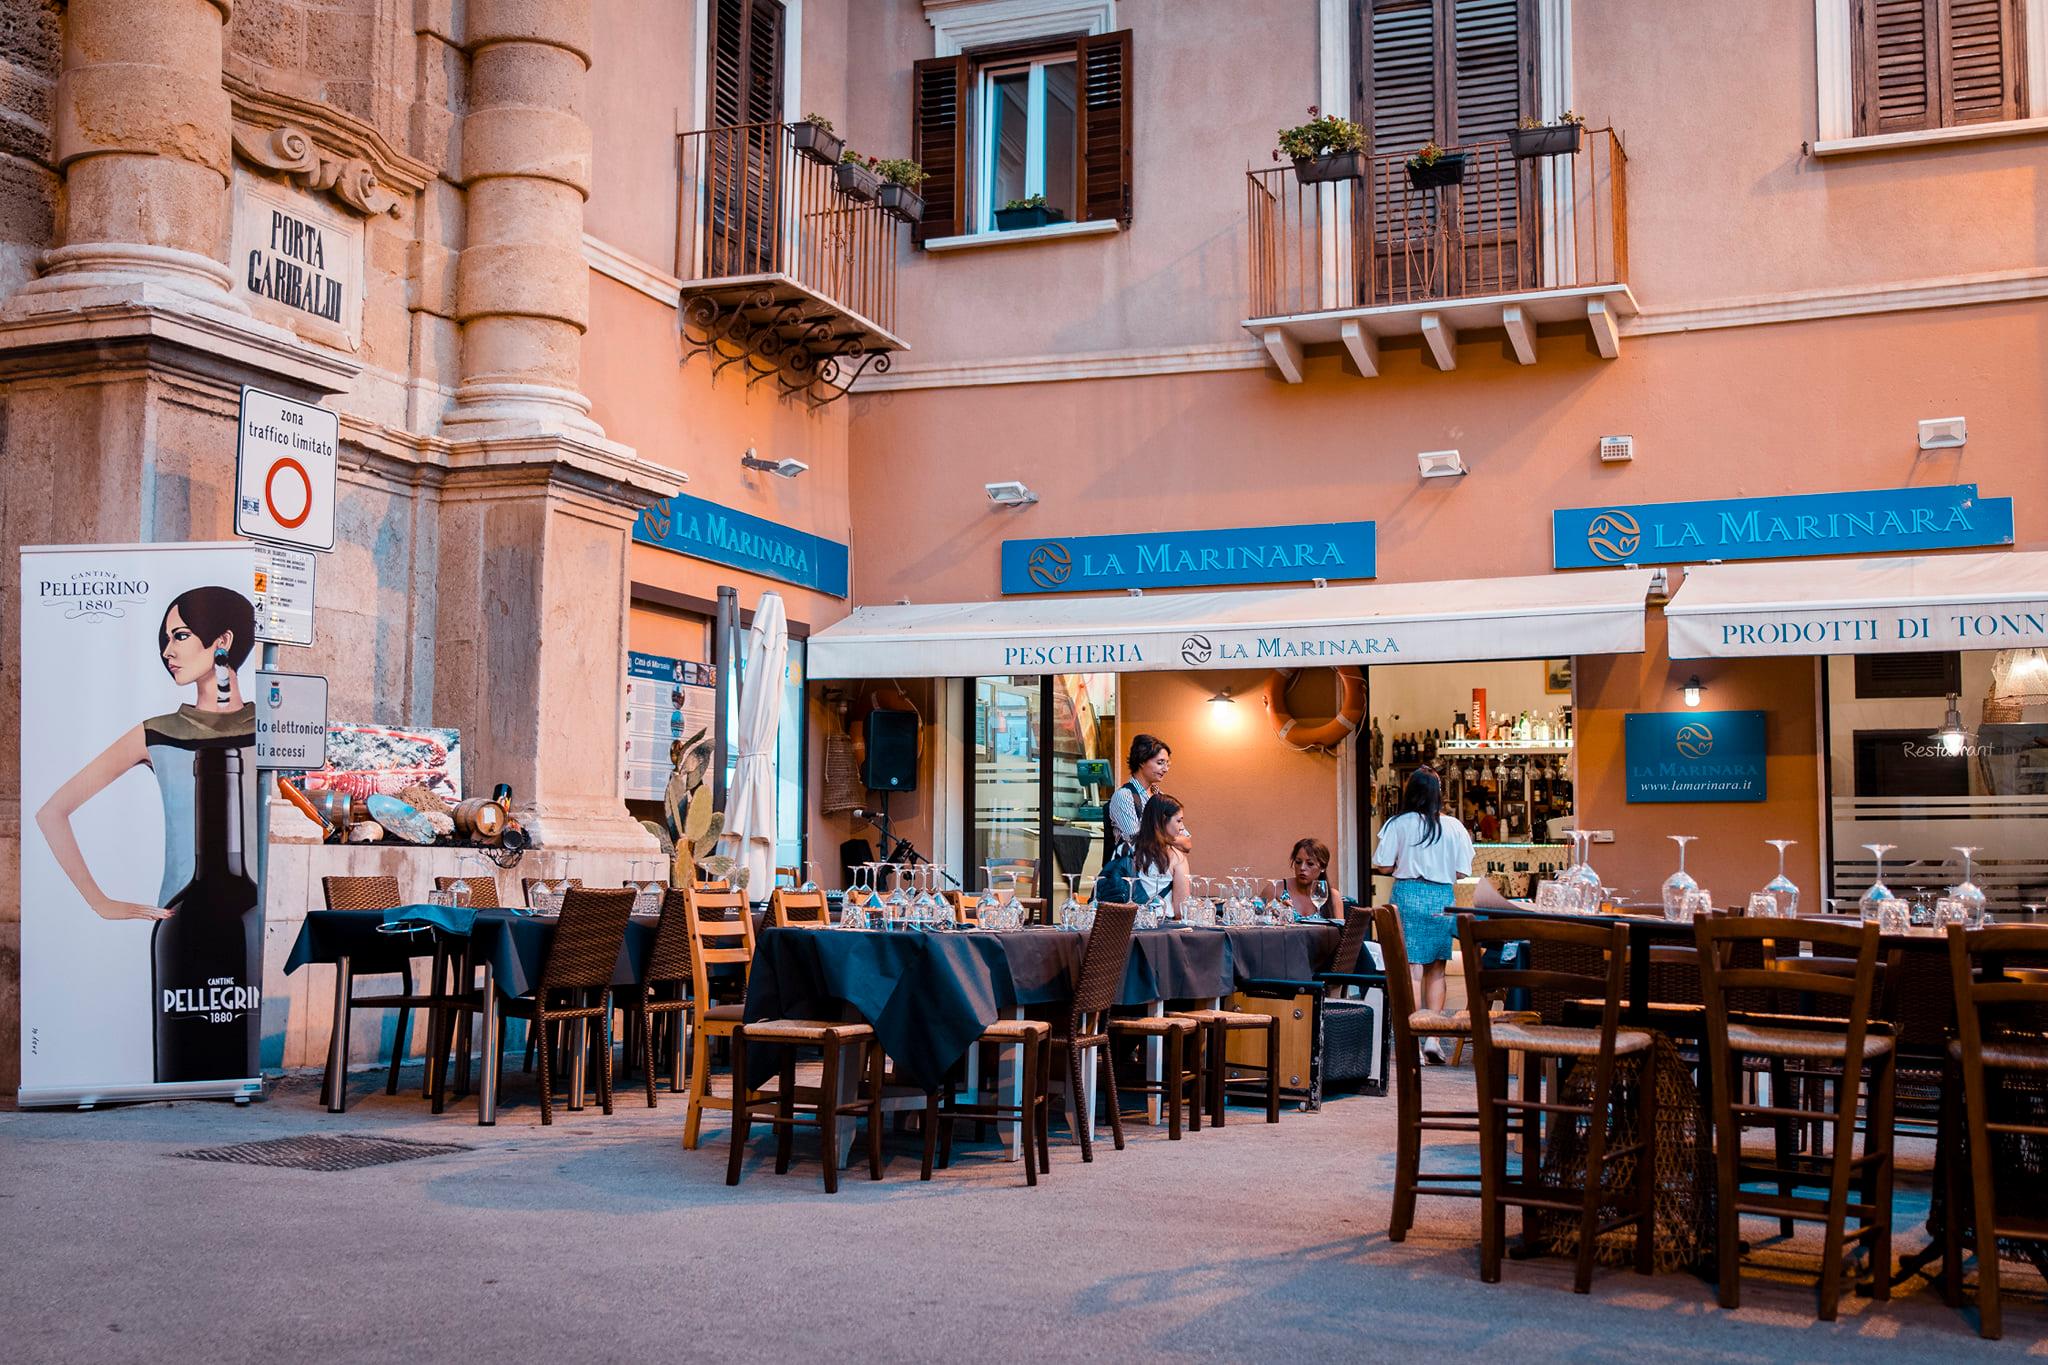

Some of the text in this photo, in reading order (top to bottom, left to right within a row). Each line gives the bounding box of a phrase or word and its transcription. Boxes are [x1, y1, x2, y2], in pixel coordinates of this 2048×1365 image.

[270, 209, 325, 271] PORTA
[247, 249, 343, 324] GARIBALDI
[280, 409, 304, 426] zona
[248, 421, 333, 457] traffico limitato
[1654, 505, 1974, 547] LA MARINARA
[676, 511, 809, 572] LA MARINARA
[1083, 542, 1346, 577] LA MARINARA
[71, 570, 118, 580] CANTINE
[40, 580, 149, 597] PELLEGRINO
[78, 600, 113, 611] 1880
[1722, 613, 2046, 645] PRODOTTI DI TONN
[1004, 637, 1400, 666] PESCHERIA LA MARINARA
[270, 719, 325, 735] elettronico
[269, 744, 306, 758] accessi
[1901, 741, 1996, 758] Restarant
[1633, 762, 1759, 777] LA MARINARA
[1640, 779, 1753, 791] www.lamarinara.it
[207, 977, 235, 986] CANTINE
[210, 1012, 233, 1023] 1880
